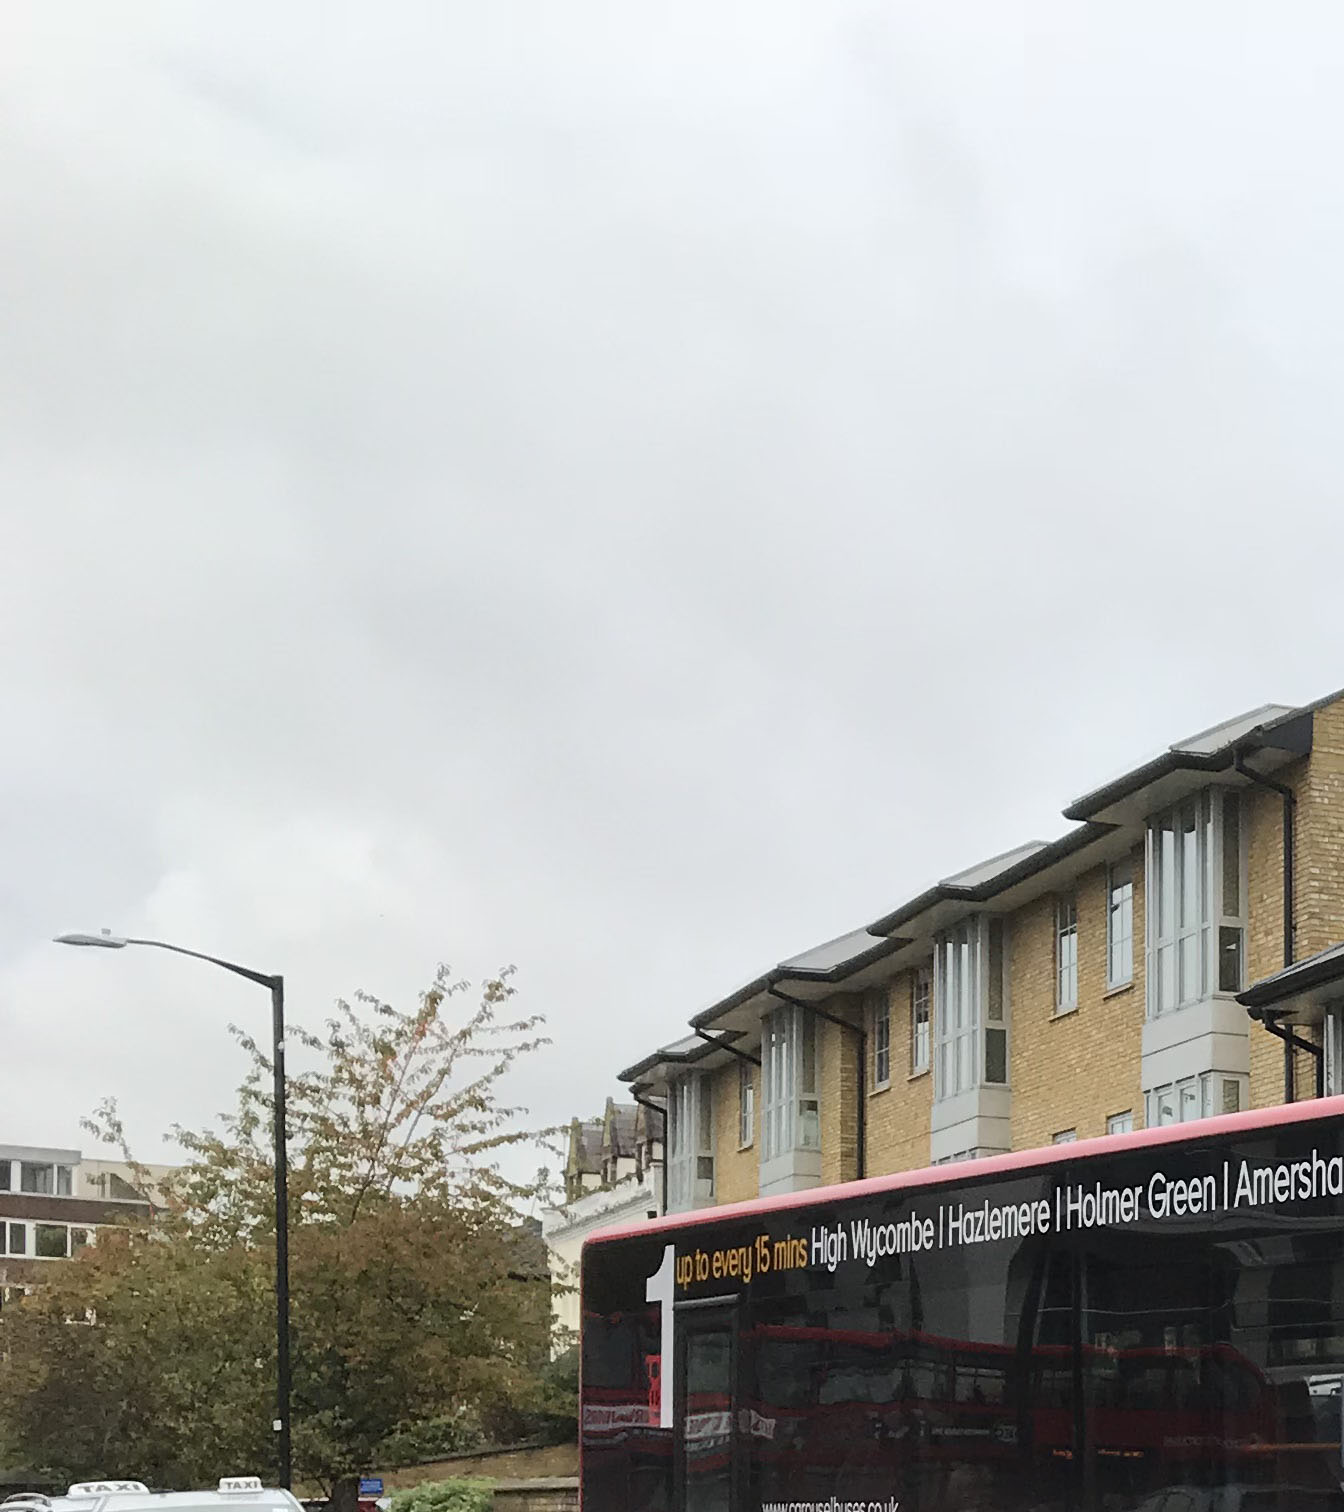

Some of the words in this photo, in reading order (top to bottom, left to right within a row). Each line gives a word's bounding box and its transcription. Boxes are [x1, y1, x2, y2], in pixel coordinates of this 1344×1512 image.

[676, 1254, 693, 1291] up
[696, 1251, 709, 1283] to
[712, 1245, 751, 1284] every
[755, 1235, 770, 1273] 15
[773, 1234, 808, 1271] mins
[811, 1223, 847, 1272] High
[851, 1211, 934, 1267] Wycombe
[949, 1199, 1050, 1247] Hazlemere
[1066, 1181, 1143, 1230] Holmer
[1149, 1172, 1216, 1219] Green
[645, 1244, 675, 1428] 1
[80, 1483, 140, 1492] TAXI
[225, 1481, 259, 1490] TAXI
